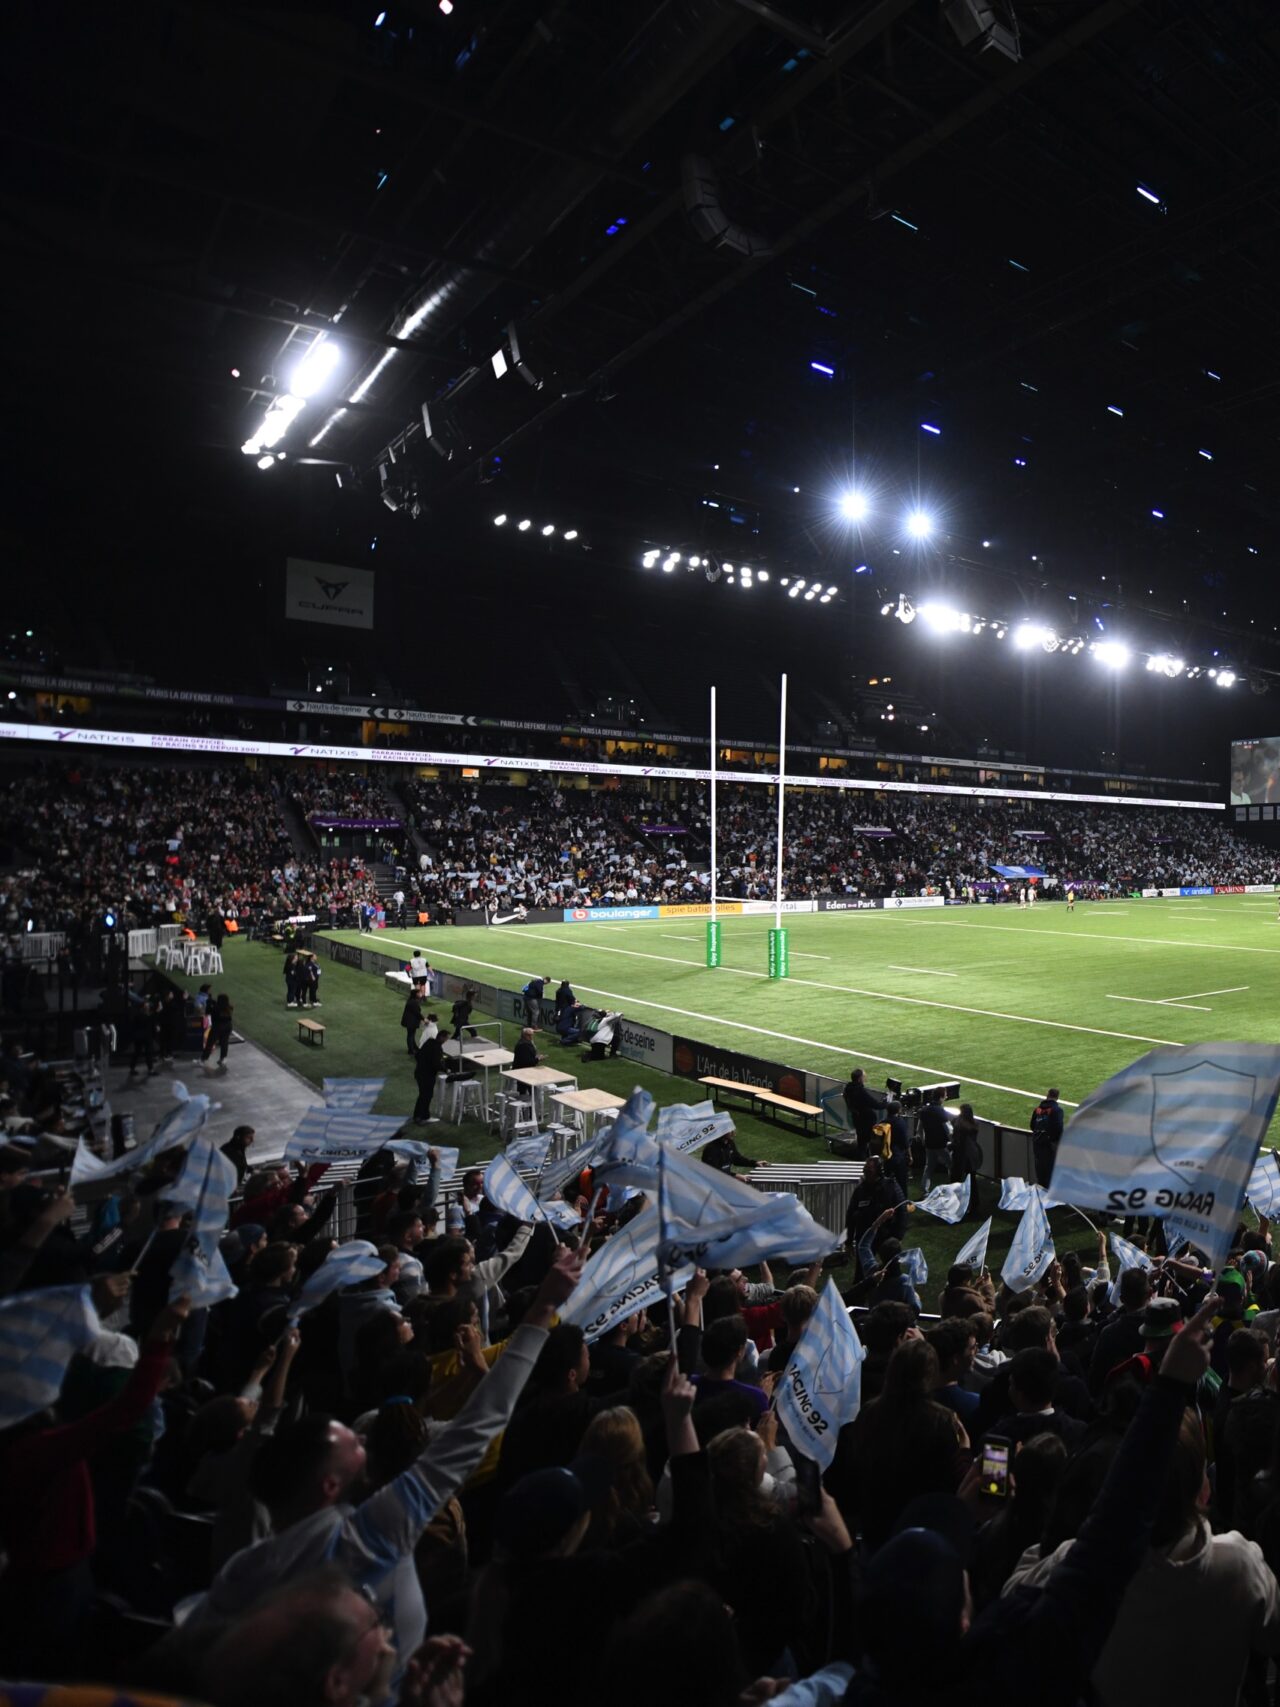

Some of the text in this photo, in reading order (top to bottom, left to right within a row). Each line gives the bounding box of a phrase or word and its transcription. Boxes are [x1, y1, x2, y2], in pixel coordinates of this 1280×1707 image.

[146, 688, 168, 698] PARIS
[180, 692, 212, 702] DEFENSE
[501, 720, 516, 728] PARIS
[524, 722, 546, 730] DEFENSE
[78, 732, 135, 743] NATIXIS
[311, 748, 359, 757] NATIXIS
[501, 760, 540, 768] NATIXIS
[667, 903, 736, 914] spie batigolles
[826, 900, 877, 909] Eden Park
[590, 910, 653, 919] boulanger
[697, 1056, 774, 1089] L'Art de la Viande
[676, 1123, 716, 1151] CING 92
[807, 1410, 829, 1436] 92
